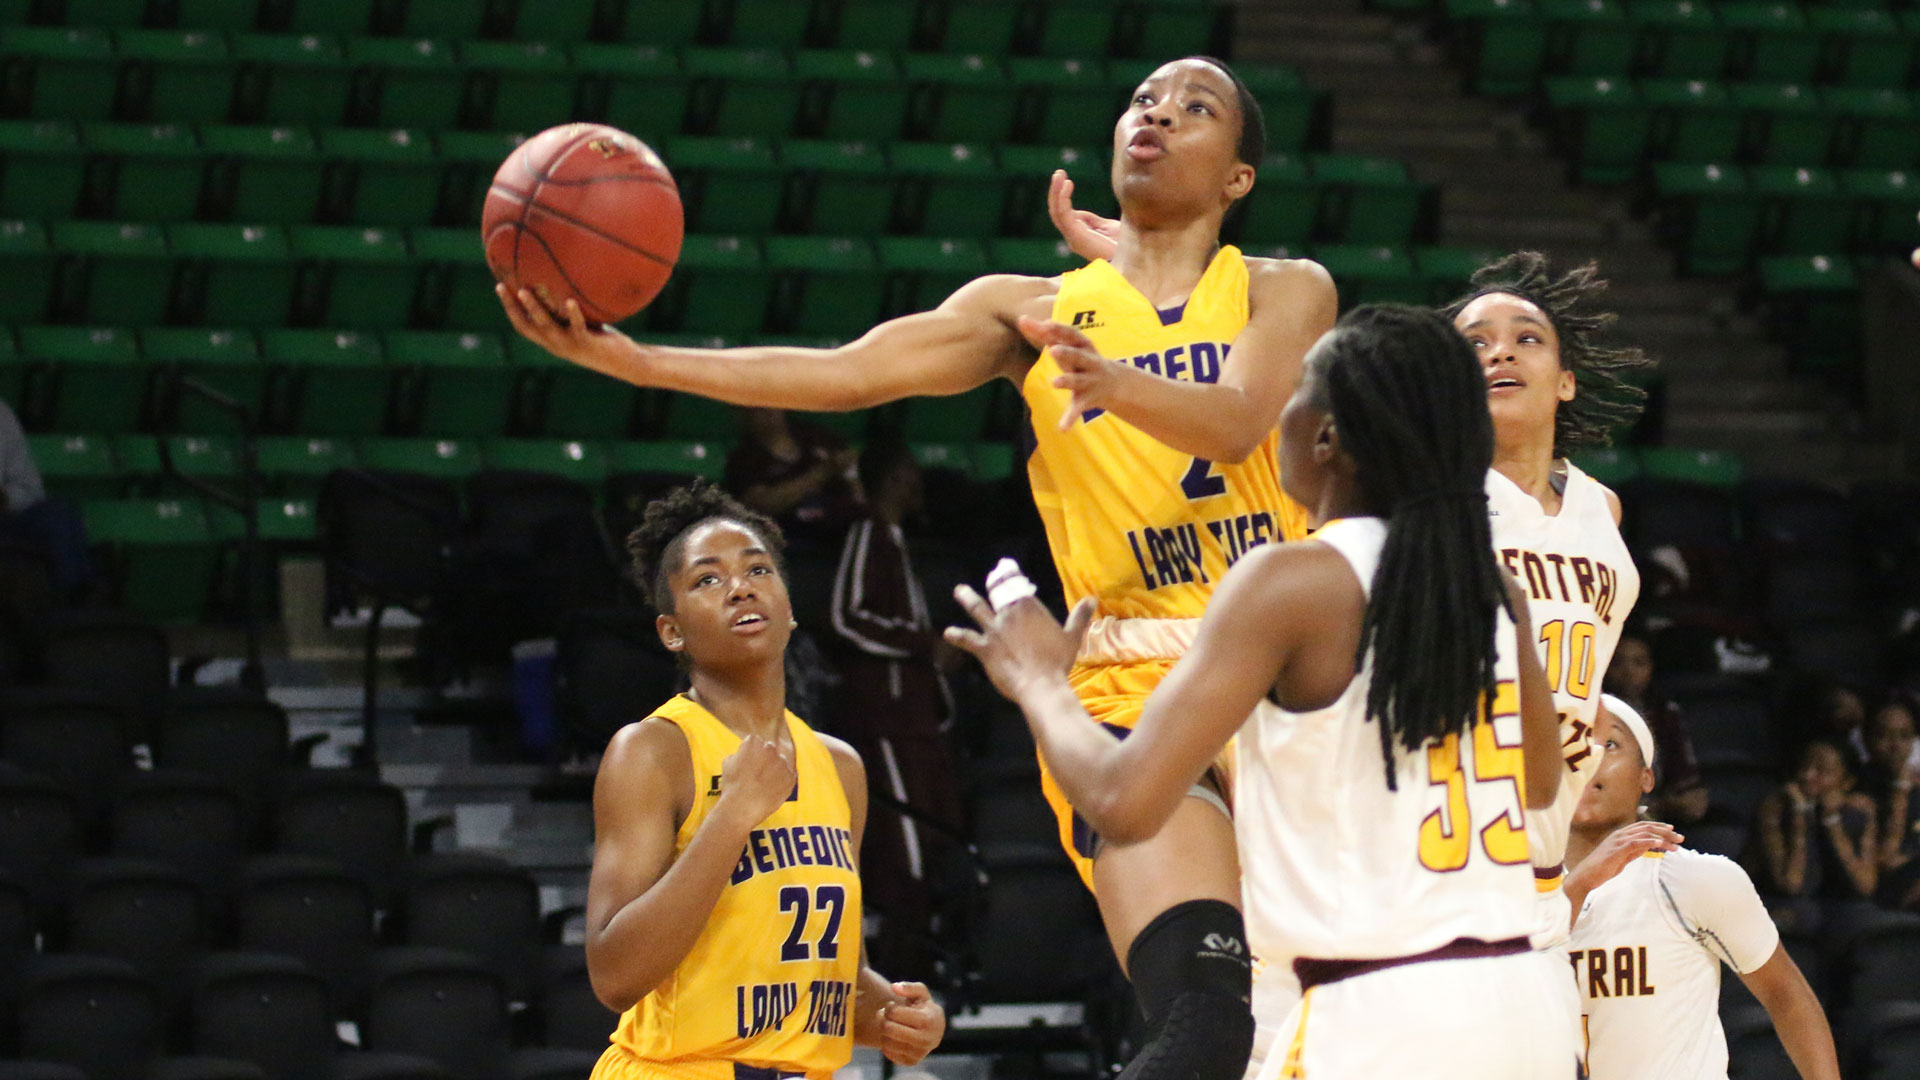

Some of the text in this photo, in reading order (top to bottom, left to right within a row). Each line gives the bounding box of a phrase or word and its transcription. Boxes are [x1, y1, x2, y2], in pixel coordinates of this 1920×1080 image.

[1127, 522, 1210, 591] LADY
[1500, 548, 1617, 626] ENTRAL
[1539, 619, 1595, 700] 10
[1418, 679, 1533, 872] 35
[730, 825, 855, 887] BENEDIC
[779, 885, 845, 962] 22
[1569, 946, 1655, 998] TRAL
[737, 982, 797, 1039] LADY
